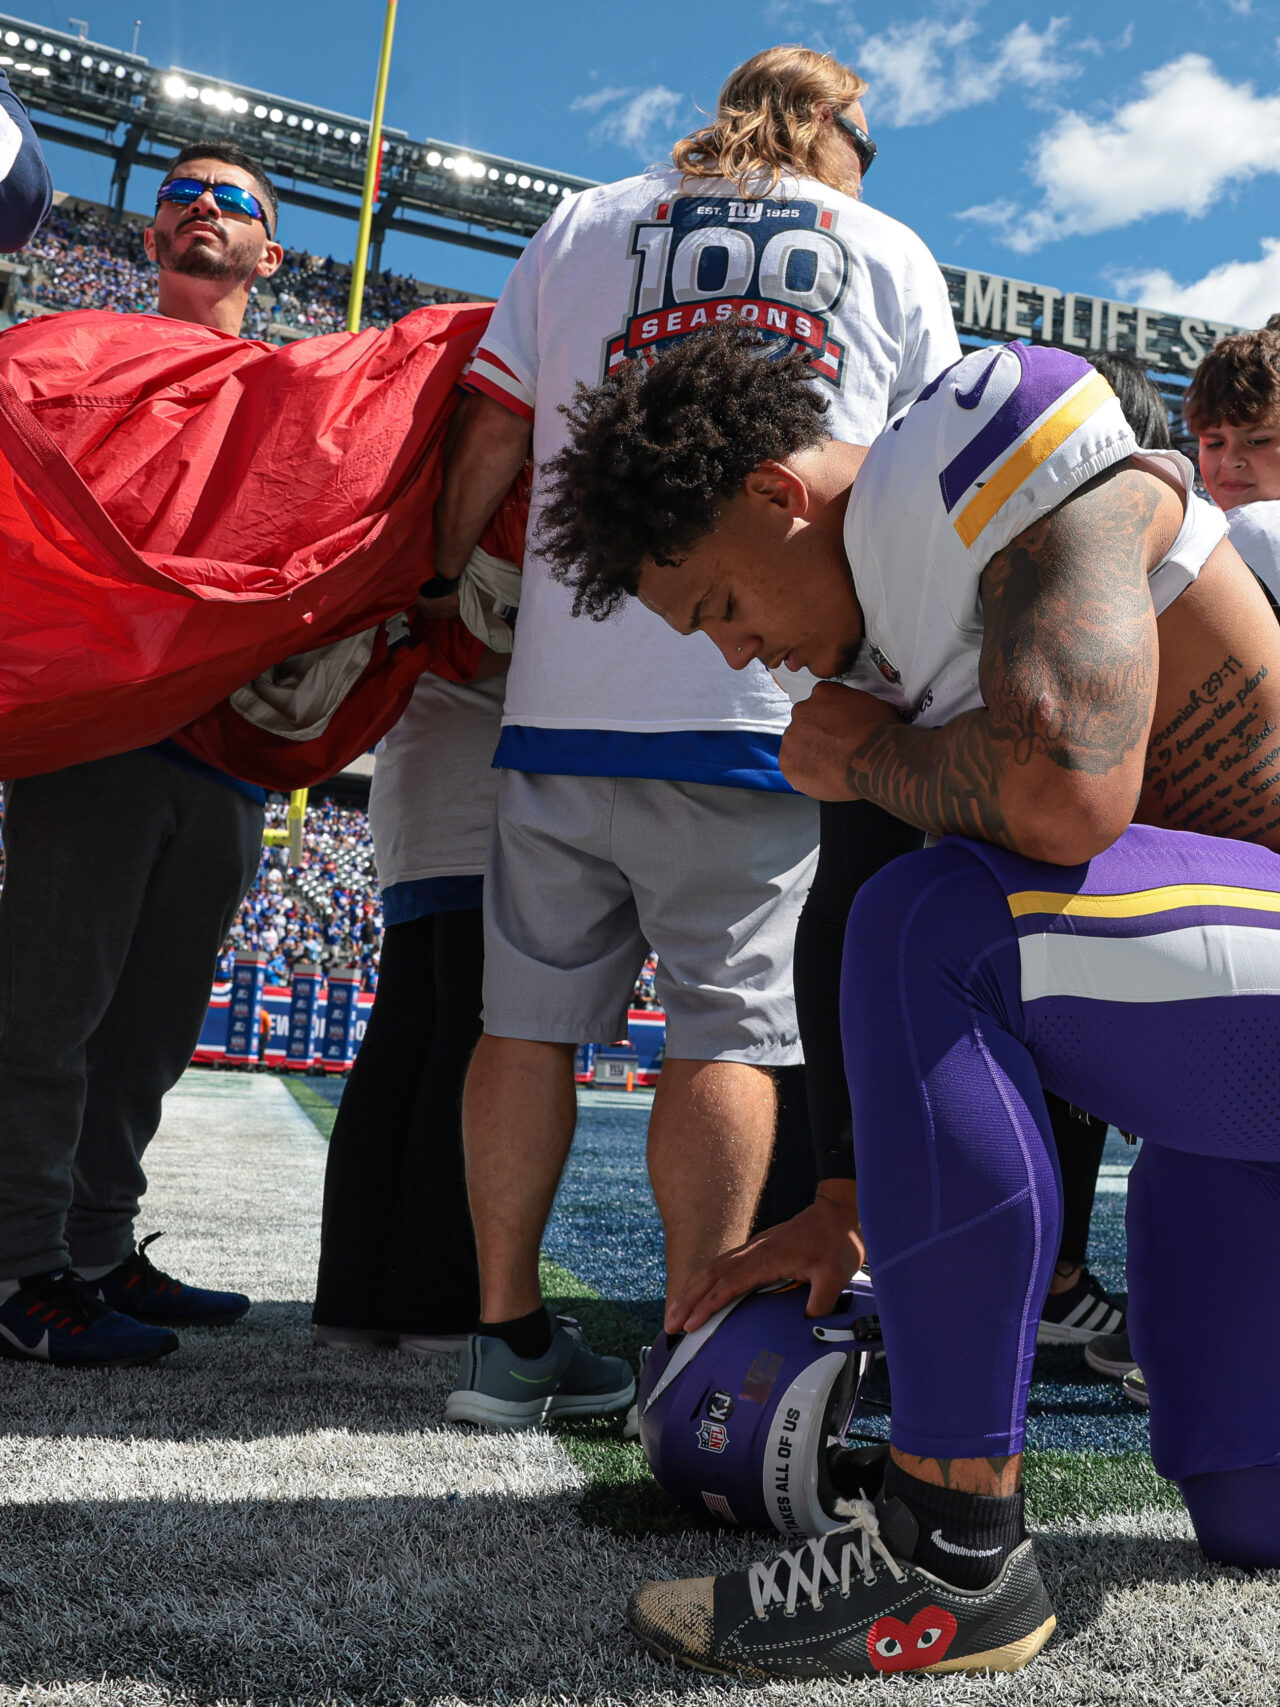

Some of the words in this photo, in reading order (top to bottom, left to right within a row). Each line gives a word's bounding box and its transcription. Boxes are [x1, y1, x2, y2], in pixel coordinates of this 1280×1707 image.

[696, 205, 723, 216] EST.
[766, 208, 800, 218] 1925
[635, 226, 845, 314] 100
[640, 302, 813, 340] SEASONS
[962, 269, 1161, 363] METLIFE
[1201, 653, 1244, 697] 29:11
[1212, 698, 1236, 721] the
[1234, 664, 1269, 708] plans
[1171, 758, 1202, 786] have
[708, 1392, 732, 1421] KJ
[783, 1406, 801, 1434] US
[709, 1427, 725, 1450] NFL
[777, 1435, 794, 1459] OF
[775, 1462, 791, 1494] ALL
[776, 1495, 801, 1531] TAKES
